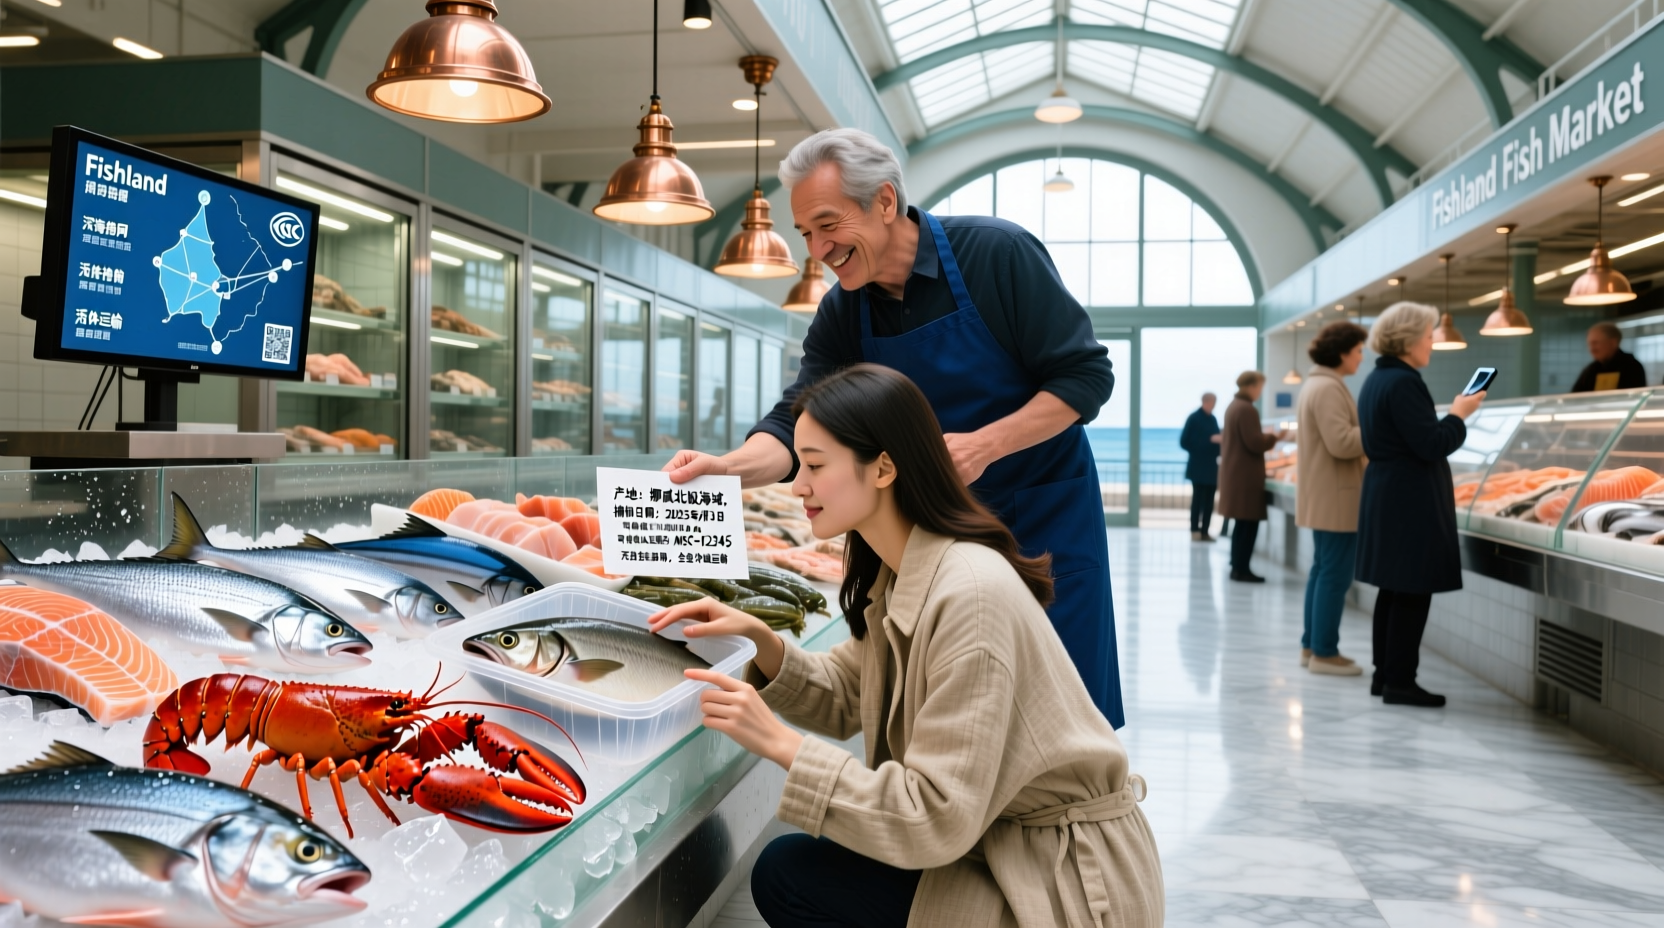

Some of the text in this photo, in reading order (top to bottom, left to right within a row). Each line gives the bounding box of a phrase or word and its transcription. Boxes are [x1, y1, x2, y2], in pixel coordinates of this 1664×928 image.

[85, 153, 168, 196] Fishland
[1432, 61, 1645, 231] Fishland Fish Market
